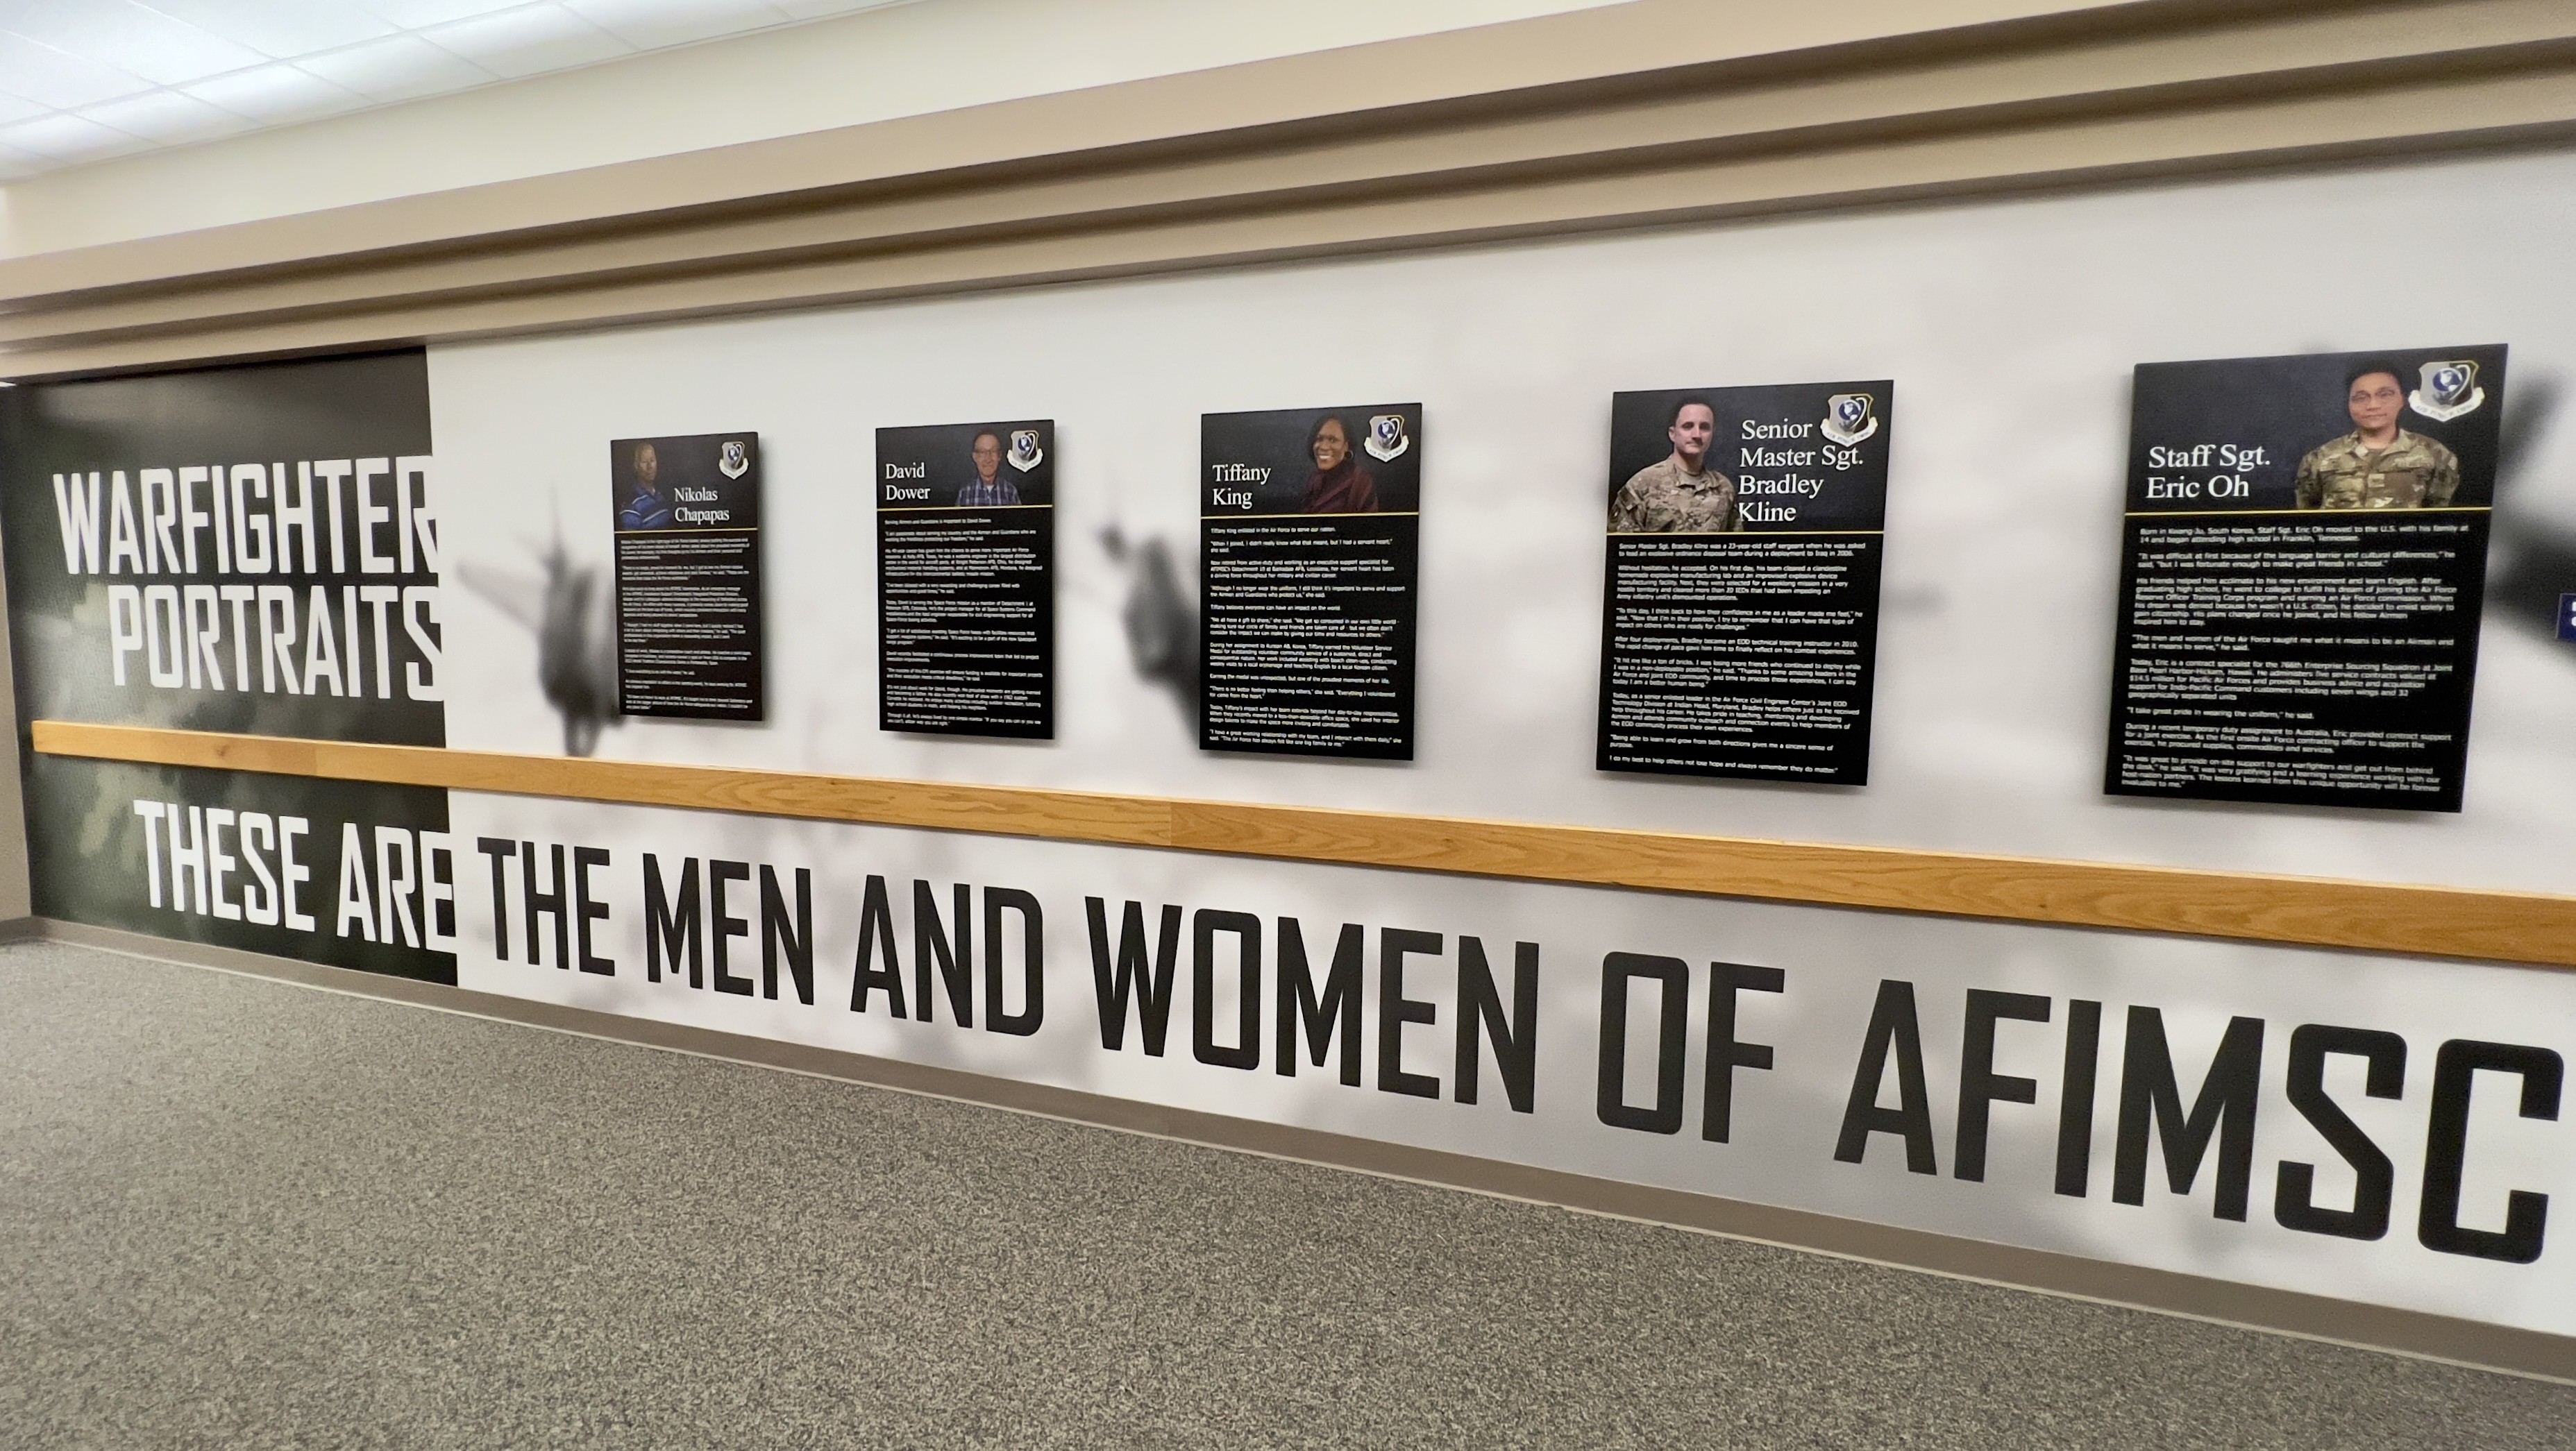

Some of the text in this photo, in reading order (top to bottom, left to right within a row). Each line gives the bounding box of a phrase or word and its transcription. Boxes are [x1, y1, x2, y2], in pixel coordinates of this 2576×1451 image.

[1742, 418, 1813, 440] Senior
[1740, 445, 1863, 470] Master Sgt.
[2148, 443, 2271, 472] Staff Sgt.
[886, 461, 925, 479] David
[1212, 463, 1272, 485] Tiffany
[674, 486, 718, 502] Nikolas
[886, 484, 931, 500] Dower
[1738, 474, 1824, 499] Bradley
[2146, 474, 2250, 498] Eric Oh
[1213, 487, 1253, 509] King
[53, 455, 438, 575] WARFIGHTER
[675, 507, 730, 525] Chapapas
[1738, 501, 1796, 522] Kline
[108, 585, 444, 702] PORTRAITS
[133, 799, 2564, 1264] THESE ARE THE MEN AND WOMEN OF AFIMSC
